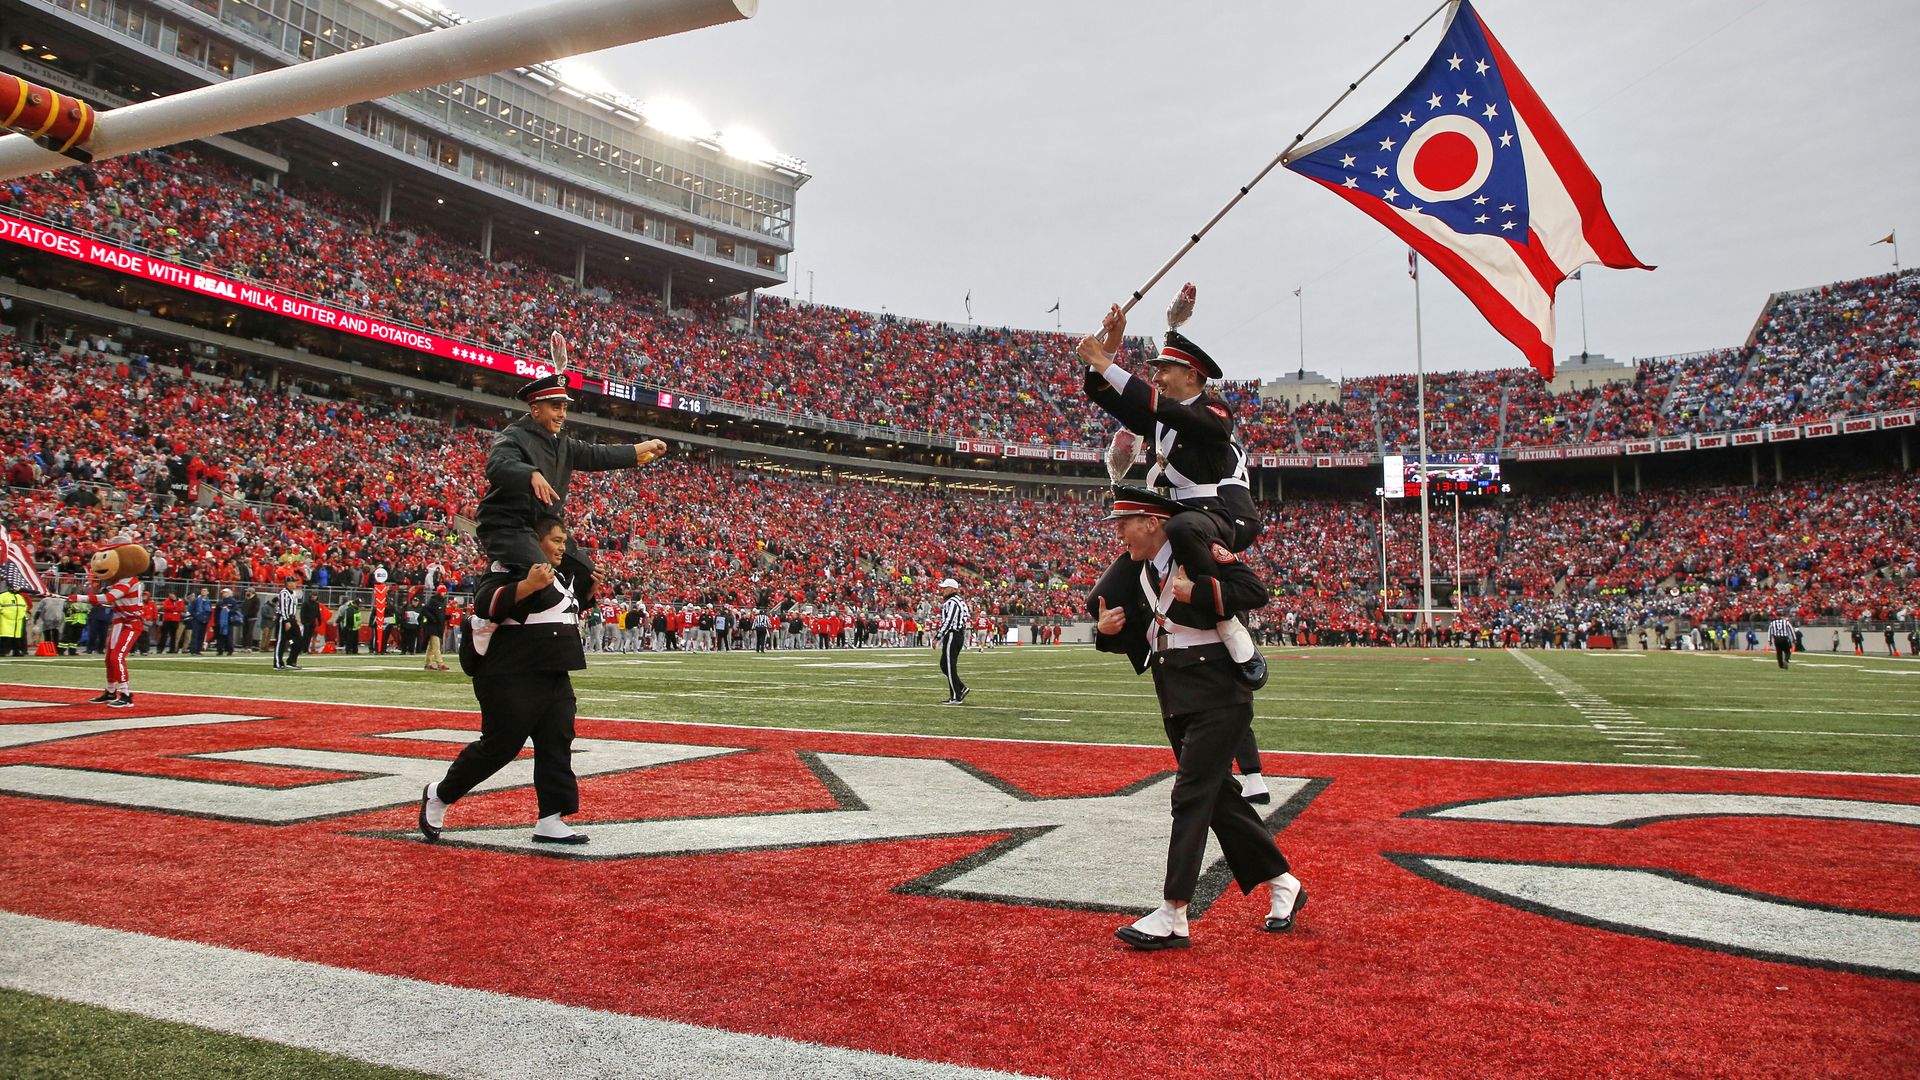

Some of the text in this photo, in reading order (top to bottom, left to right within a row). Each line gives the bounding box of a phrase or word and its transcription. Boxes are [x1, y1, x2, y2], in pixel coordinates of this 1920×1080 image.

[90, 246, 142, 272] MADE
[148, 261, 190, 285] WITH
[193, 274, 236, 299] REAL
[240, 288, 278, 311] MILK,
[282, 300, 336, 325] BUTTER
[339, 316, 368, 333] AND
[371, 323, 435, 351] POTATOES.
[514, 359, 535, 376] Bob
[678, 397, 701, 412] 2:16
[1884, 415, 1911, 427] 2014
[1808, 425, 1833, 435] 1970
[958, 442, 996, 453] 10 SMITH
[1518, 447, 1619, 460] NATIONAL CHAMPIONS
[1055, 451, 1097, 460] 27 GEORGE
[1335, 457, 1364, 466] WILLIS
[1279, 458, 1309, 466] HARLEY
[118, 631, 134, 682] OHIO STATE
